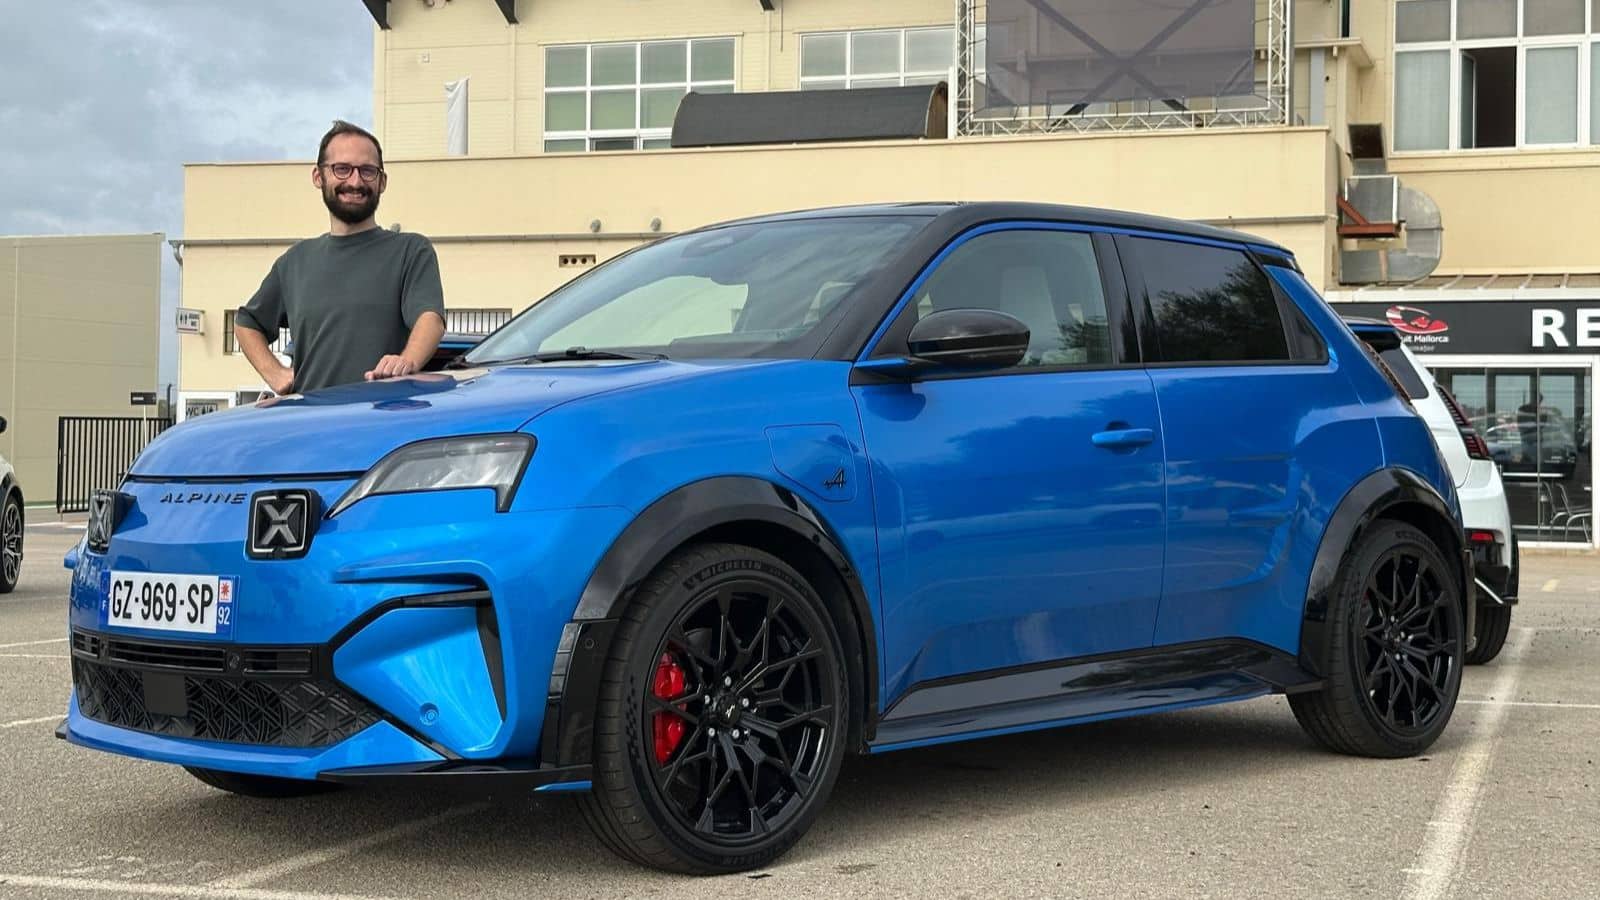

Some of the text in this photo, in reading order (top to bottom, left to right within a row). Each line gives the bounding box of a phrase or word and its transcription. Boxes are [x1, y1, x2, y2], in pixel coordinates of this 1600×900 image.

[1532, 308, 1600, 347] RE
[1414, 335, 1449, 343] Mallorca
[160, 492, 248, 505] ALPINE
[698, 559, 762, 579] MICHELIN
[112, 579, 213, 625] GZ-969-SP
[217, 606, 230, 625] 92
